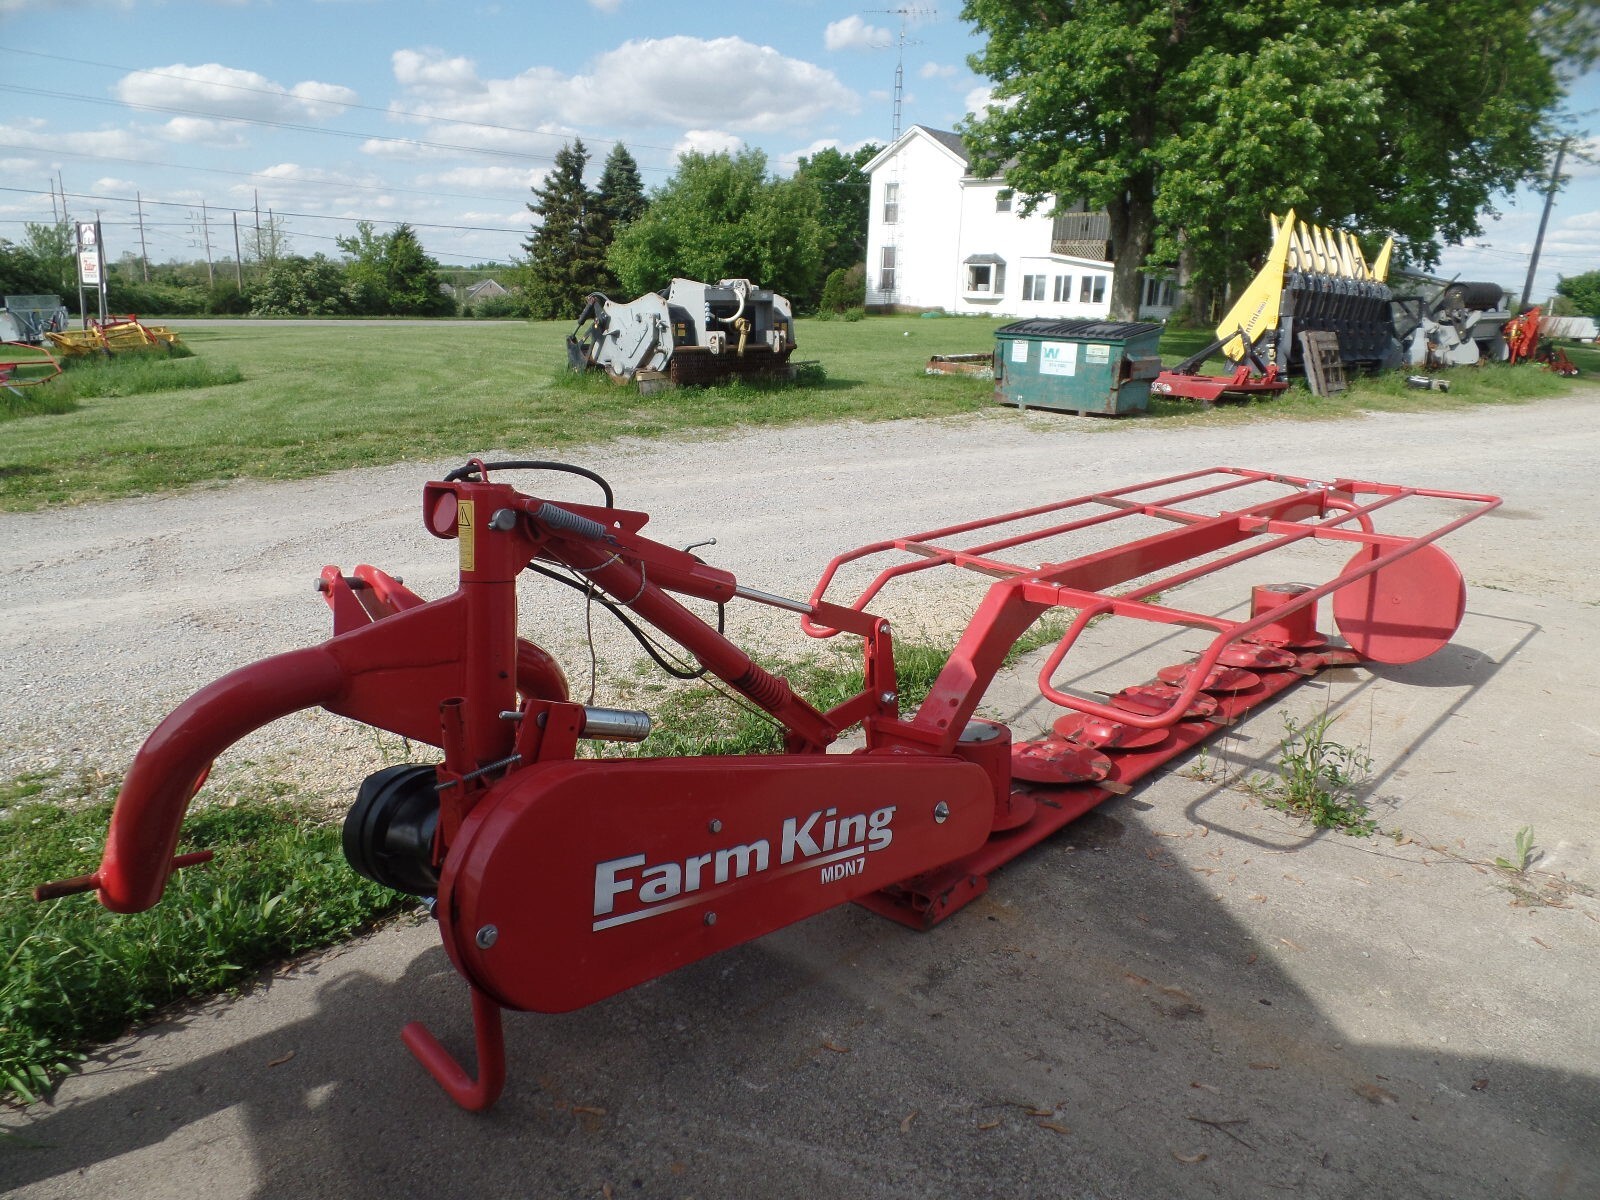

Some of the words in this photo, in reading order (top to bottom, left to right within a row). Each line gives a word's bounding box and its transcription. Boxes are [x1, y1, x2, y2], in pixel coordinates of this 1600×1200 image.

[593, 838, 770, 917] Farm
[780, 805, 897, 865] King
[820, 857, 866, 885] MDN7
